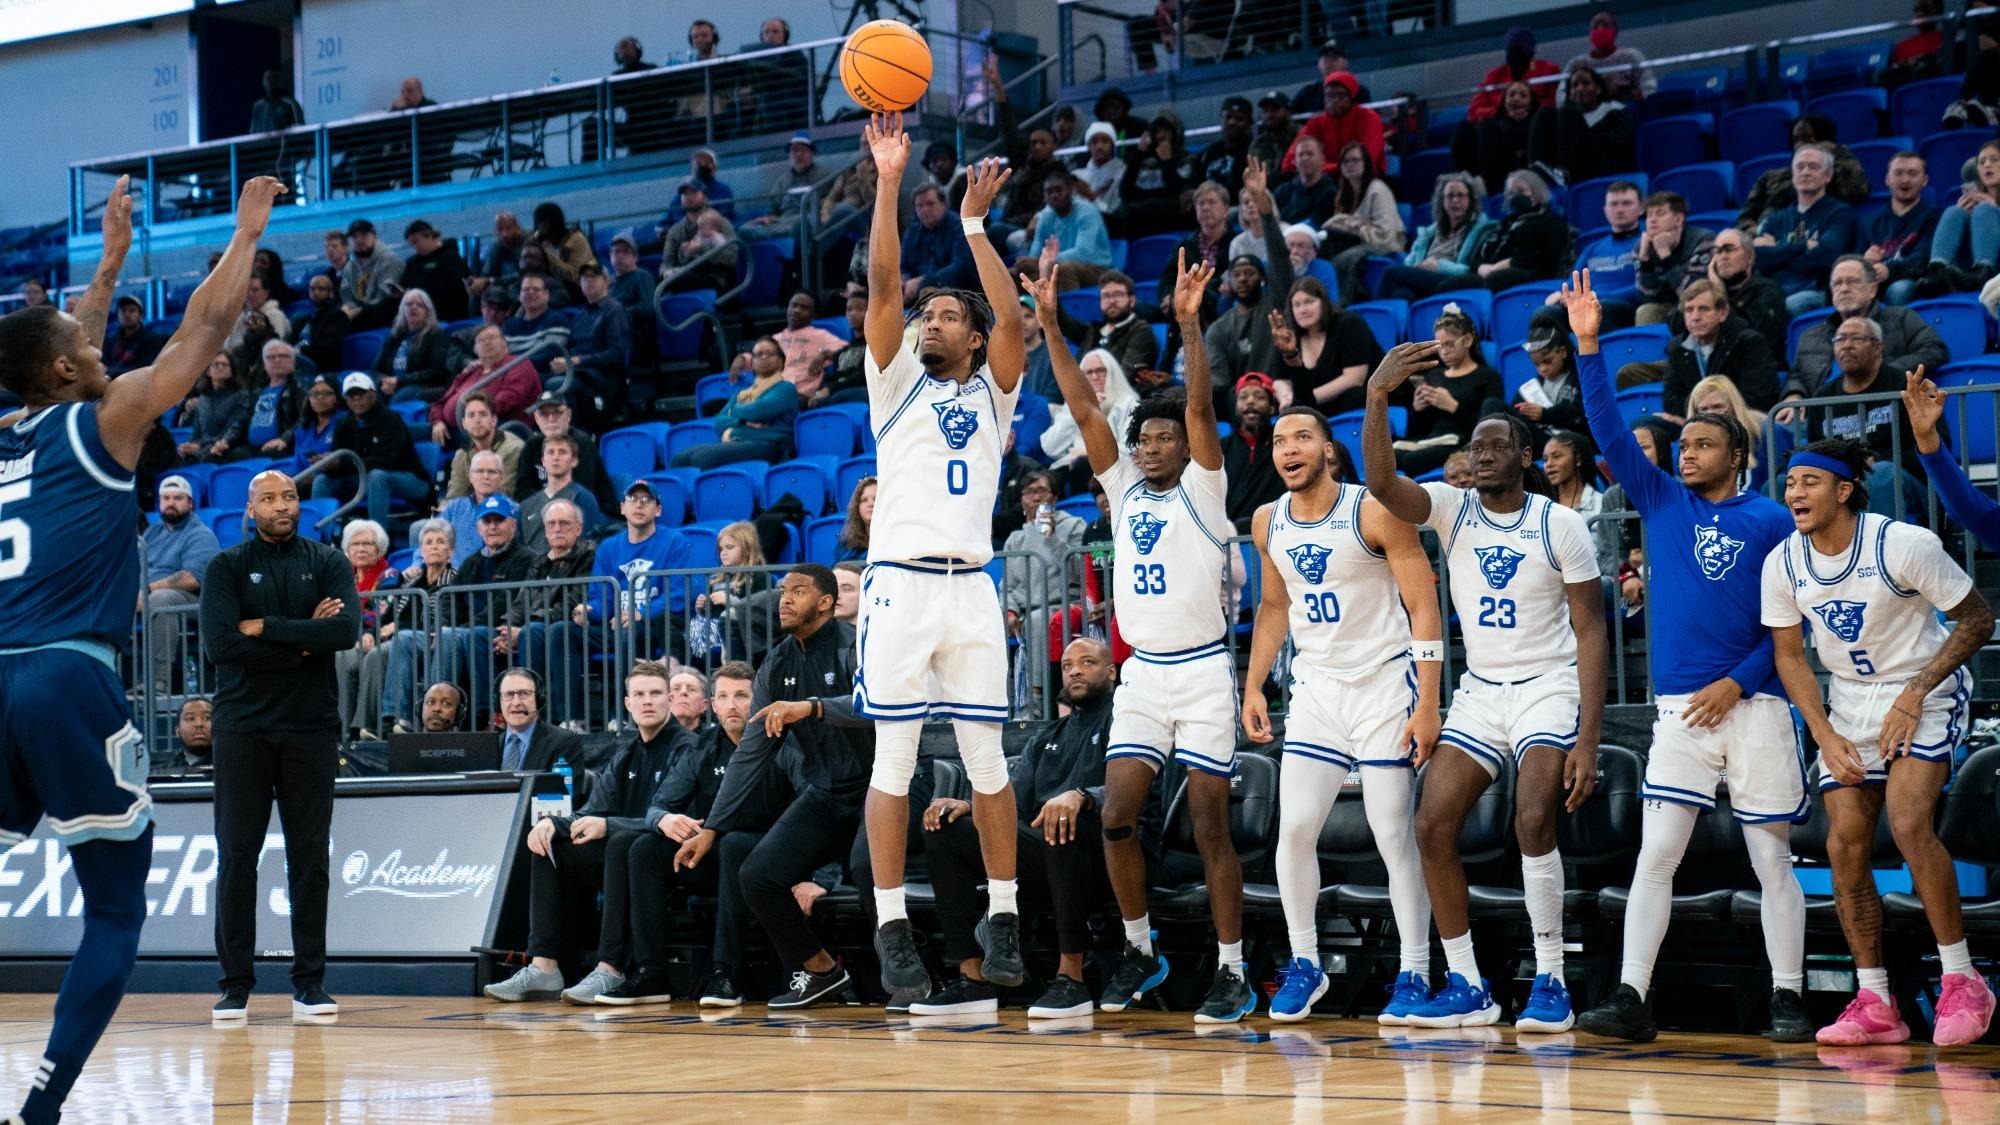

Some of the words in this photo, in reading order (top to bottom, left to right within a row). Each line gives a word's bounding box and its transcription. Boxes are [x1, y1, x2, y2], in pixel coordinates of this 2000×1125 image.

[317, 37, 342, 58] 201
[153, 64, 178, 87] 201
[318, 82, 342, 105] 101
[153, 109, 178, 131] 100
[947, 460, 968, 495] 0
[1134, 564, 1167, 594] 33
[1304, 592, 1340, 623] 30
[1479, 596, 1516, 629] 23
[1848, 649, 1876, 676] 5
[420, 749, 465, 757] SCEPTRE
[263, 949, 295, 957] DAKTRO
